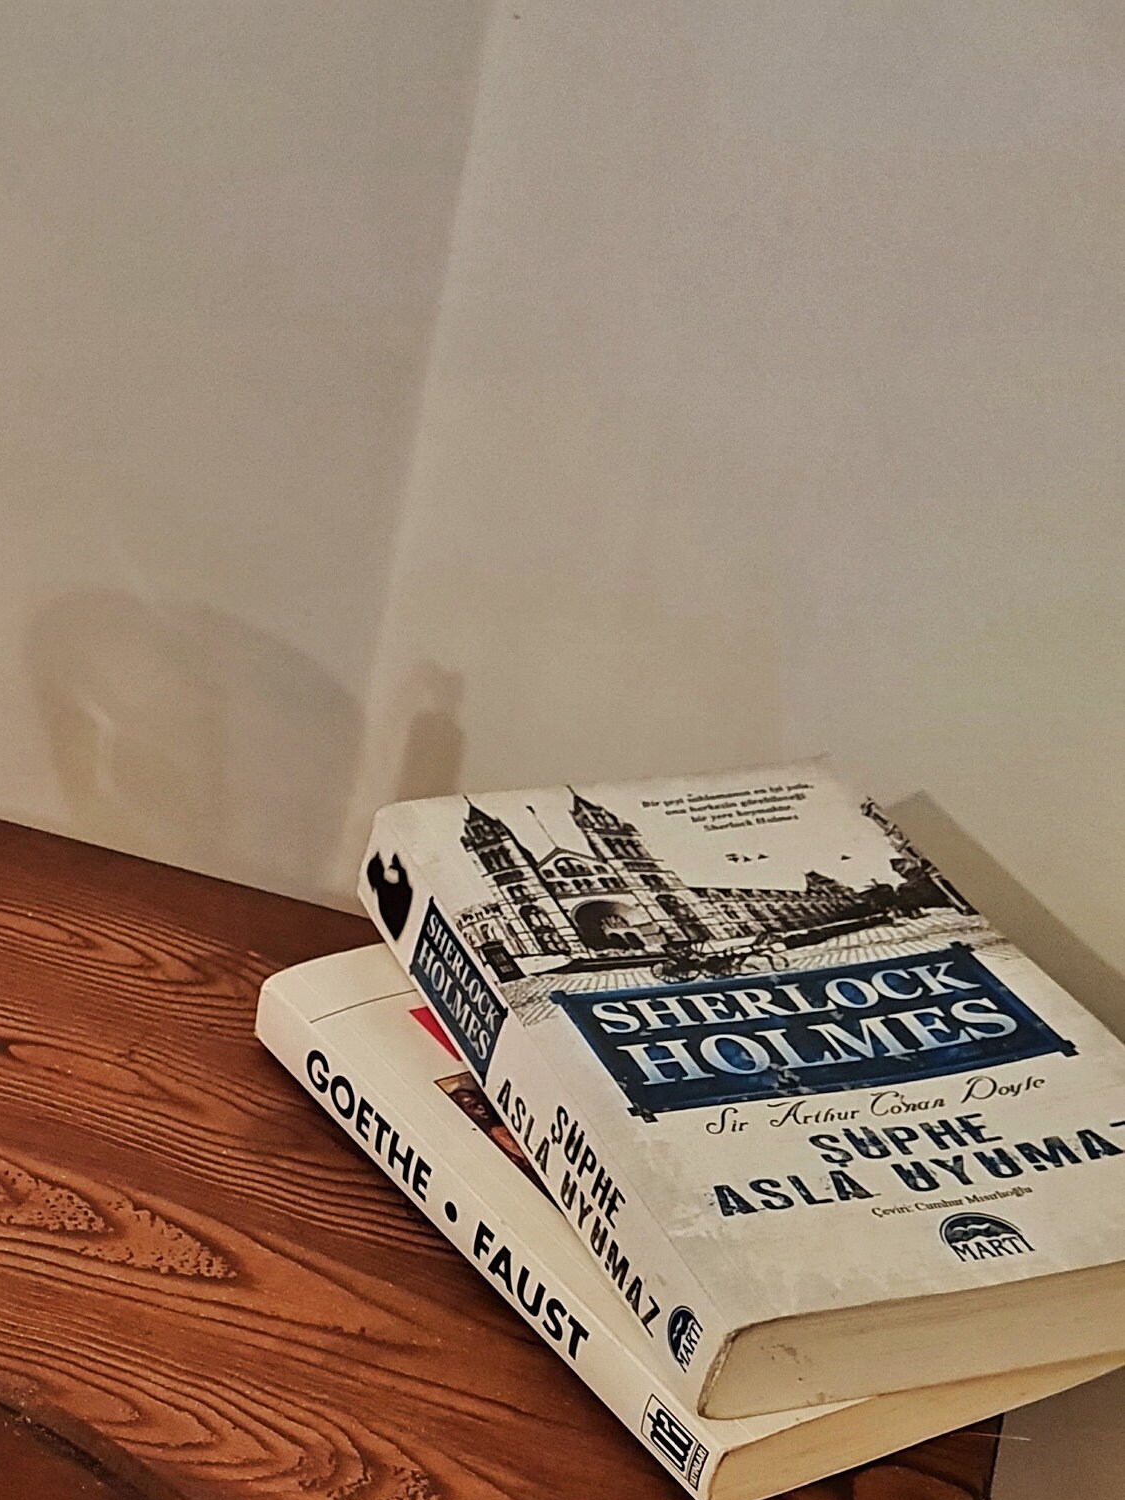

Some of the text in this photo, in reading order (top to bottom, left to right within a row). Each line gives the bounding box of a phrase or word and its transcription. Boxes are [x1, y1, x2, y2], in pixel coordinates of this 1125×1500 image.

[418, 938, 491, 1060] HOLMES
[426, 914, 500, 1032] SHERLOCK
[592, 961, 981, 1035] SHERLOCK
[617, 997, 1018, 1086] HOLMES
[706, 1075, 1046, 1134] Sir Arthur Conan Doyle
[307, 1050, 589, 1360] GOETHE FAUST
[497, 1078, 661, 1337] ASLA UYUMAZ
[712, 1170, 878, 1217] ASLA
[871, 1205, 914, 1218] Çeviri:
[915, 1199, 964, 1212] Cumhur
[950, 1234, 1035, 1262] MARTI
[677, 1318, 703, 1373] MARTI
